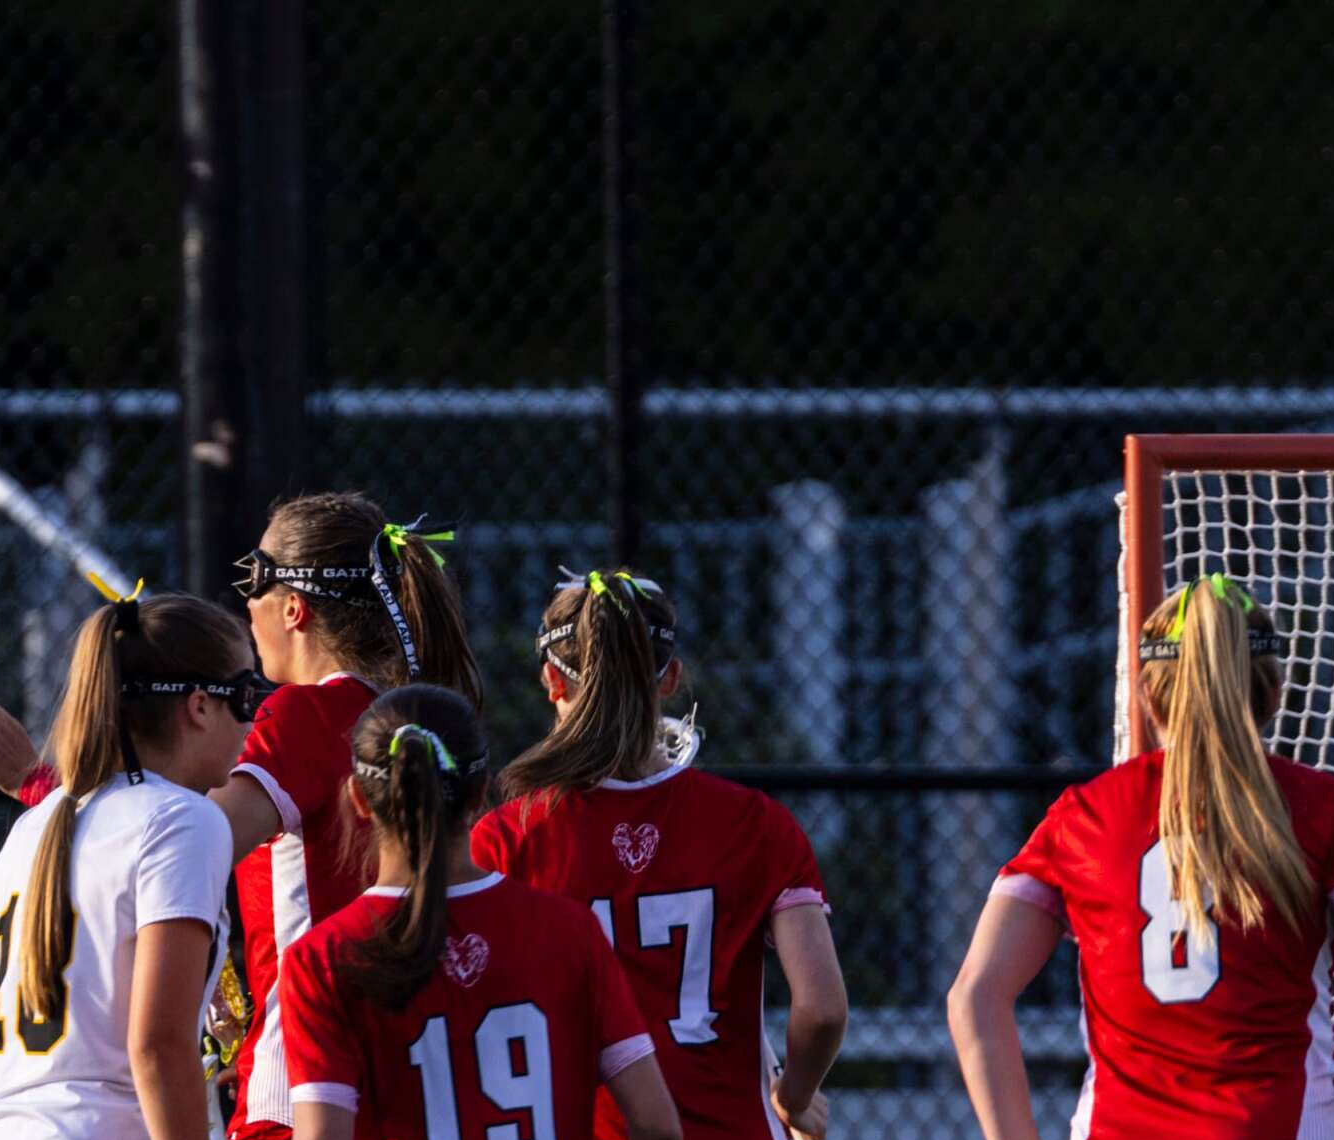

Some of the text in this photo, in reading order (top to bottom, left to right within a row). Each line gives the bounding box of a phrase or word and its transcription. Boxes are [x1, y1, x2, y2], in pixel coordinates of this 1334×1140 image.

[275, 566, 315, 579] GAIT
[322, 566, 368, 579] GAIT
[151, 682, 186, 692] GAIT
[1138, 835, 1222, 1005] 8
